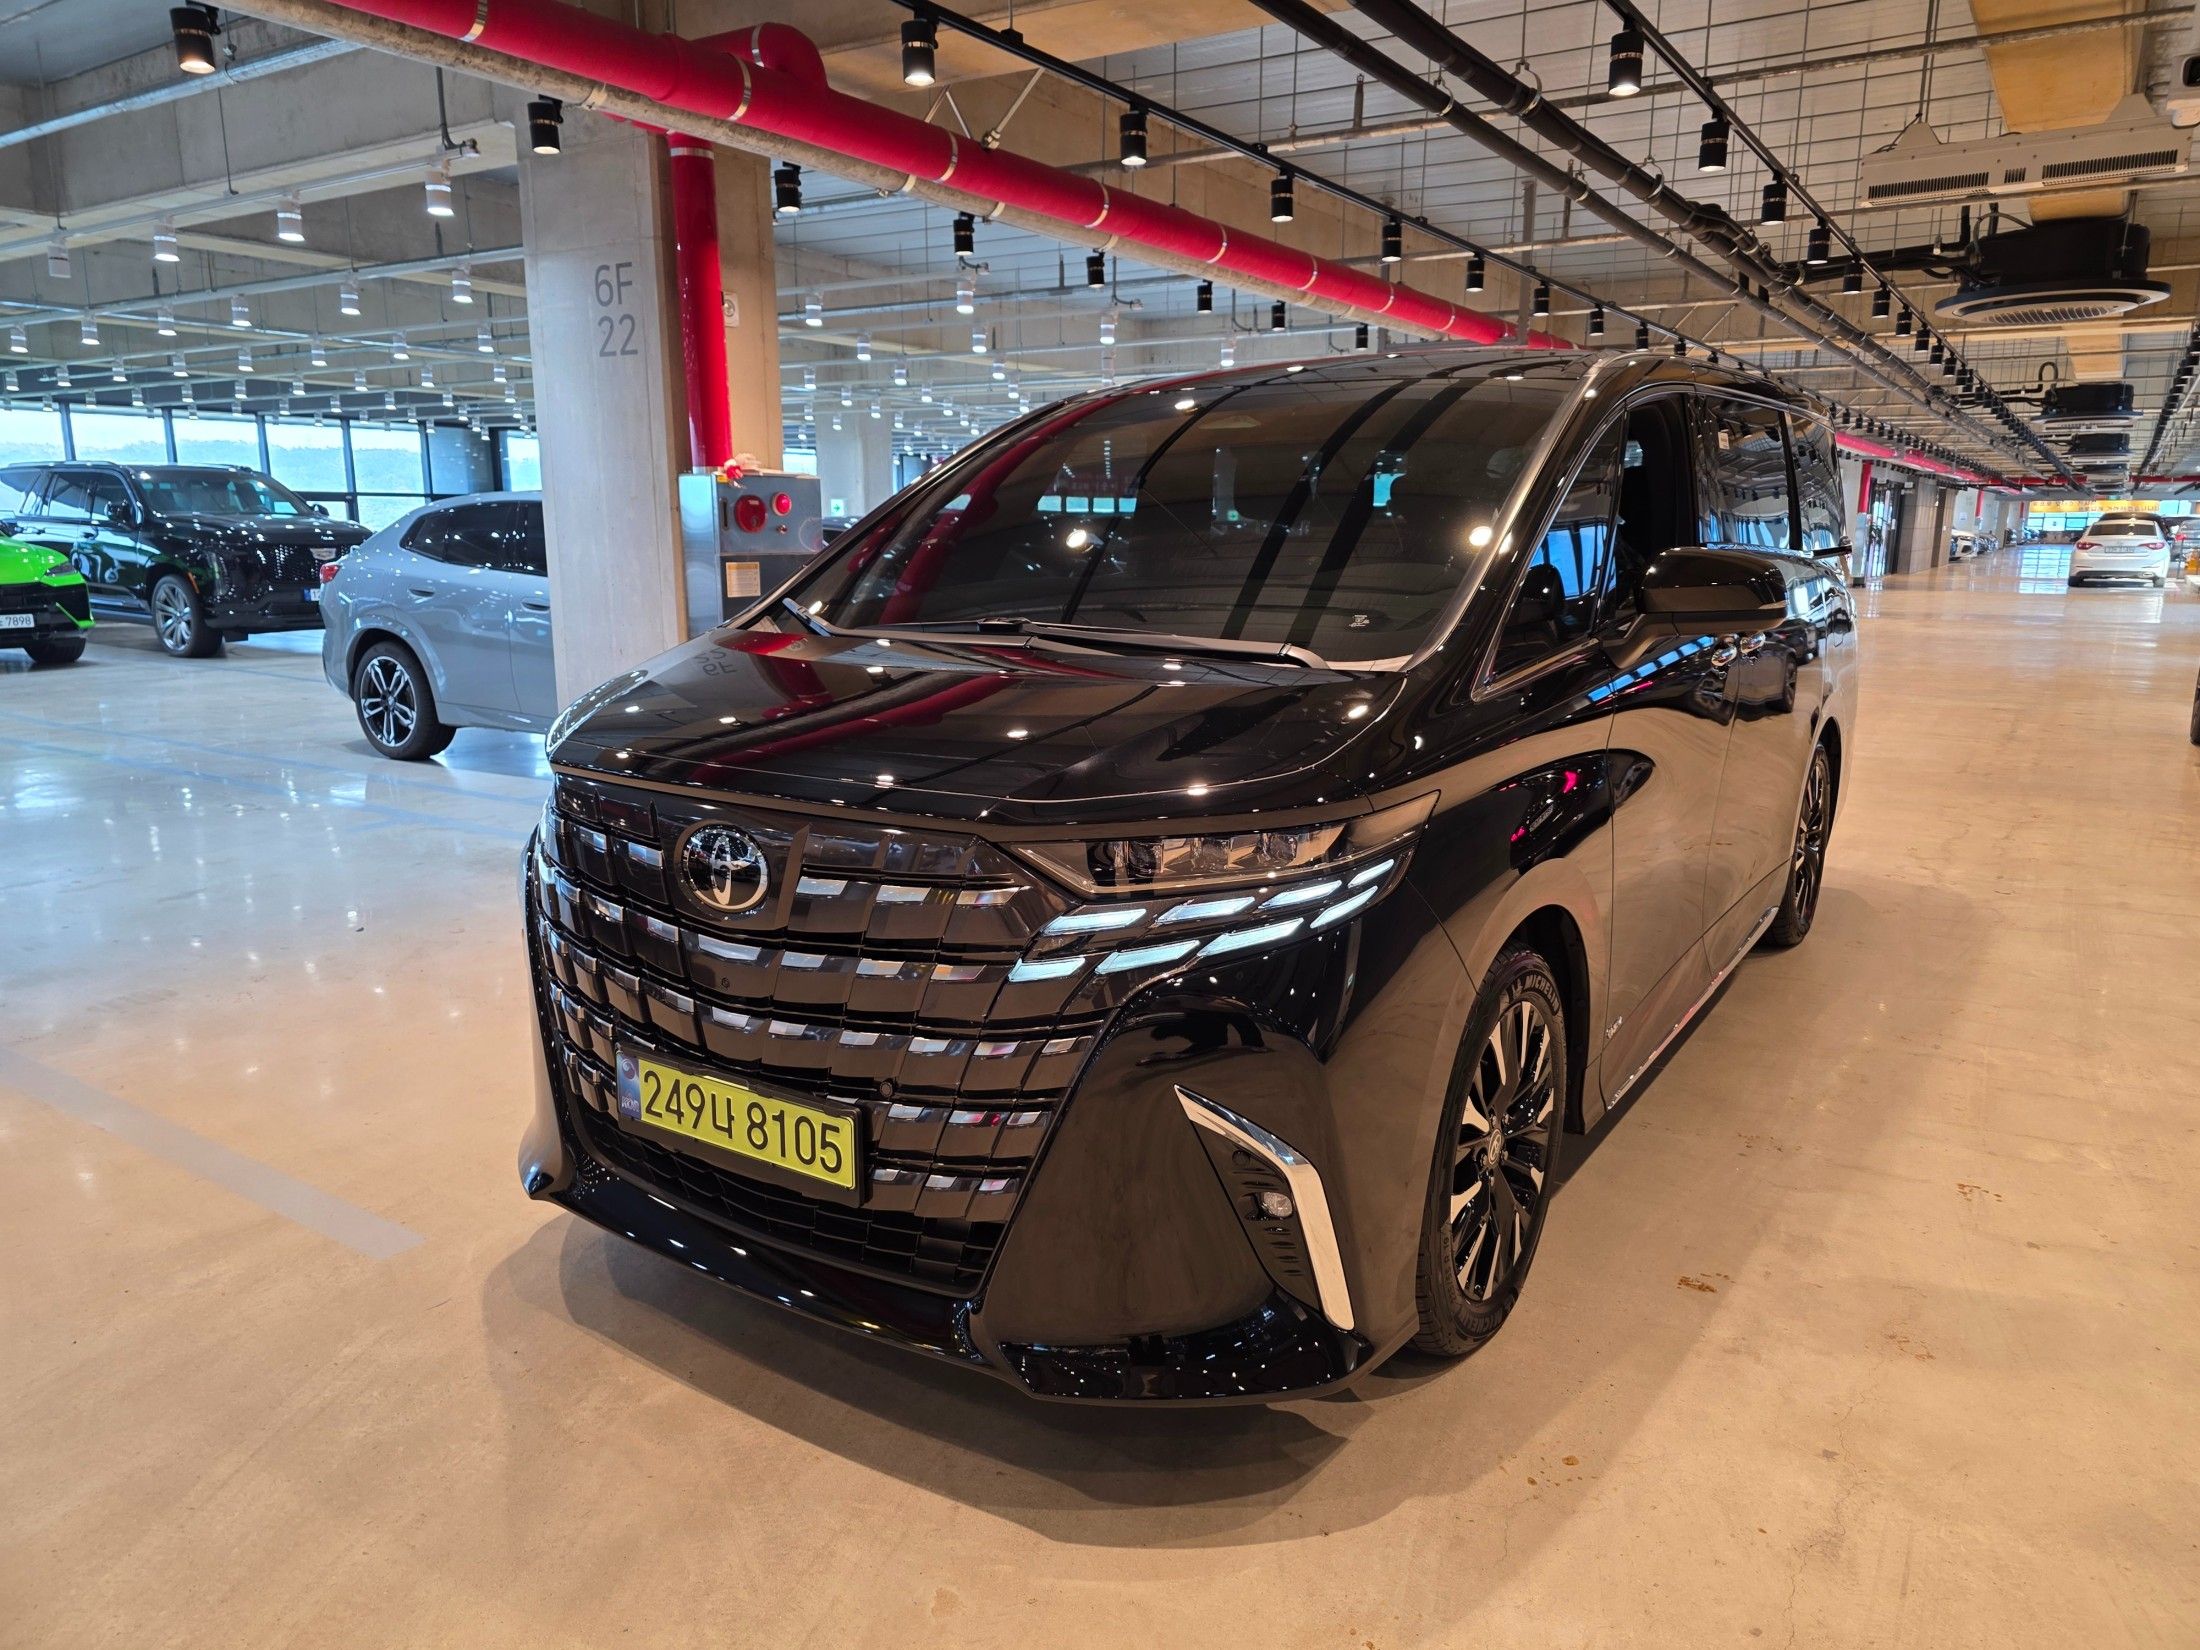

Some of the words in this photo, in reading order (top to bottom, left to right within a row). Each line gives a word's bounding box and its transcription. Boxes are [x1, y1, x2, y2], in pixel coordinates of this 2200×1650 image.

[595, 262, 632, 307] 6F
[598, 314, 638, 357] 22
[5, 616, 31, 627] 7898
[1524, 974, 1560, 1012] MICHELIN
[643, 1070, 735, 1140] 249나
[746, 1101, 842, 1174] 8105
